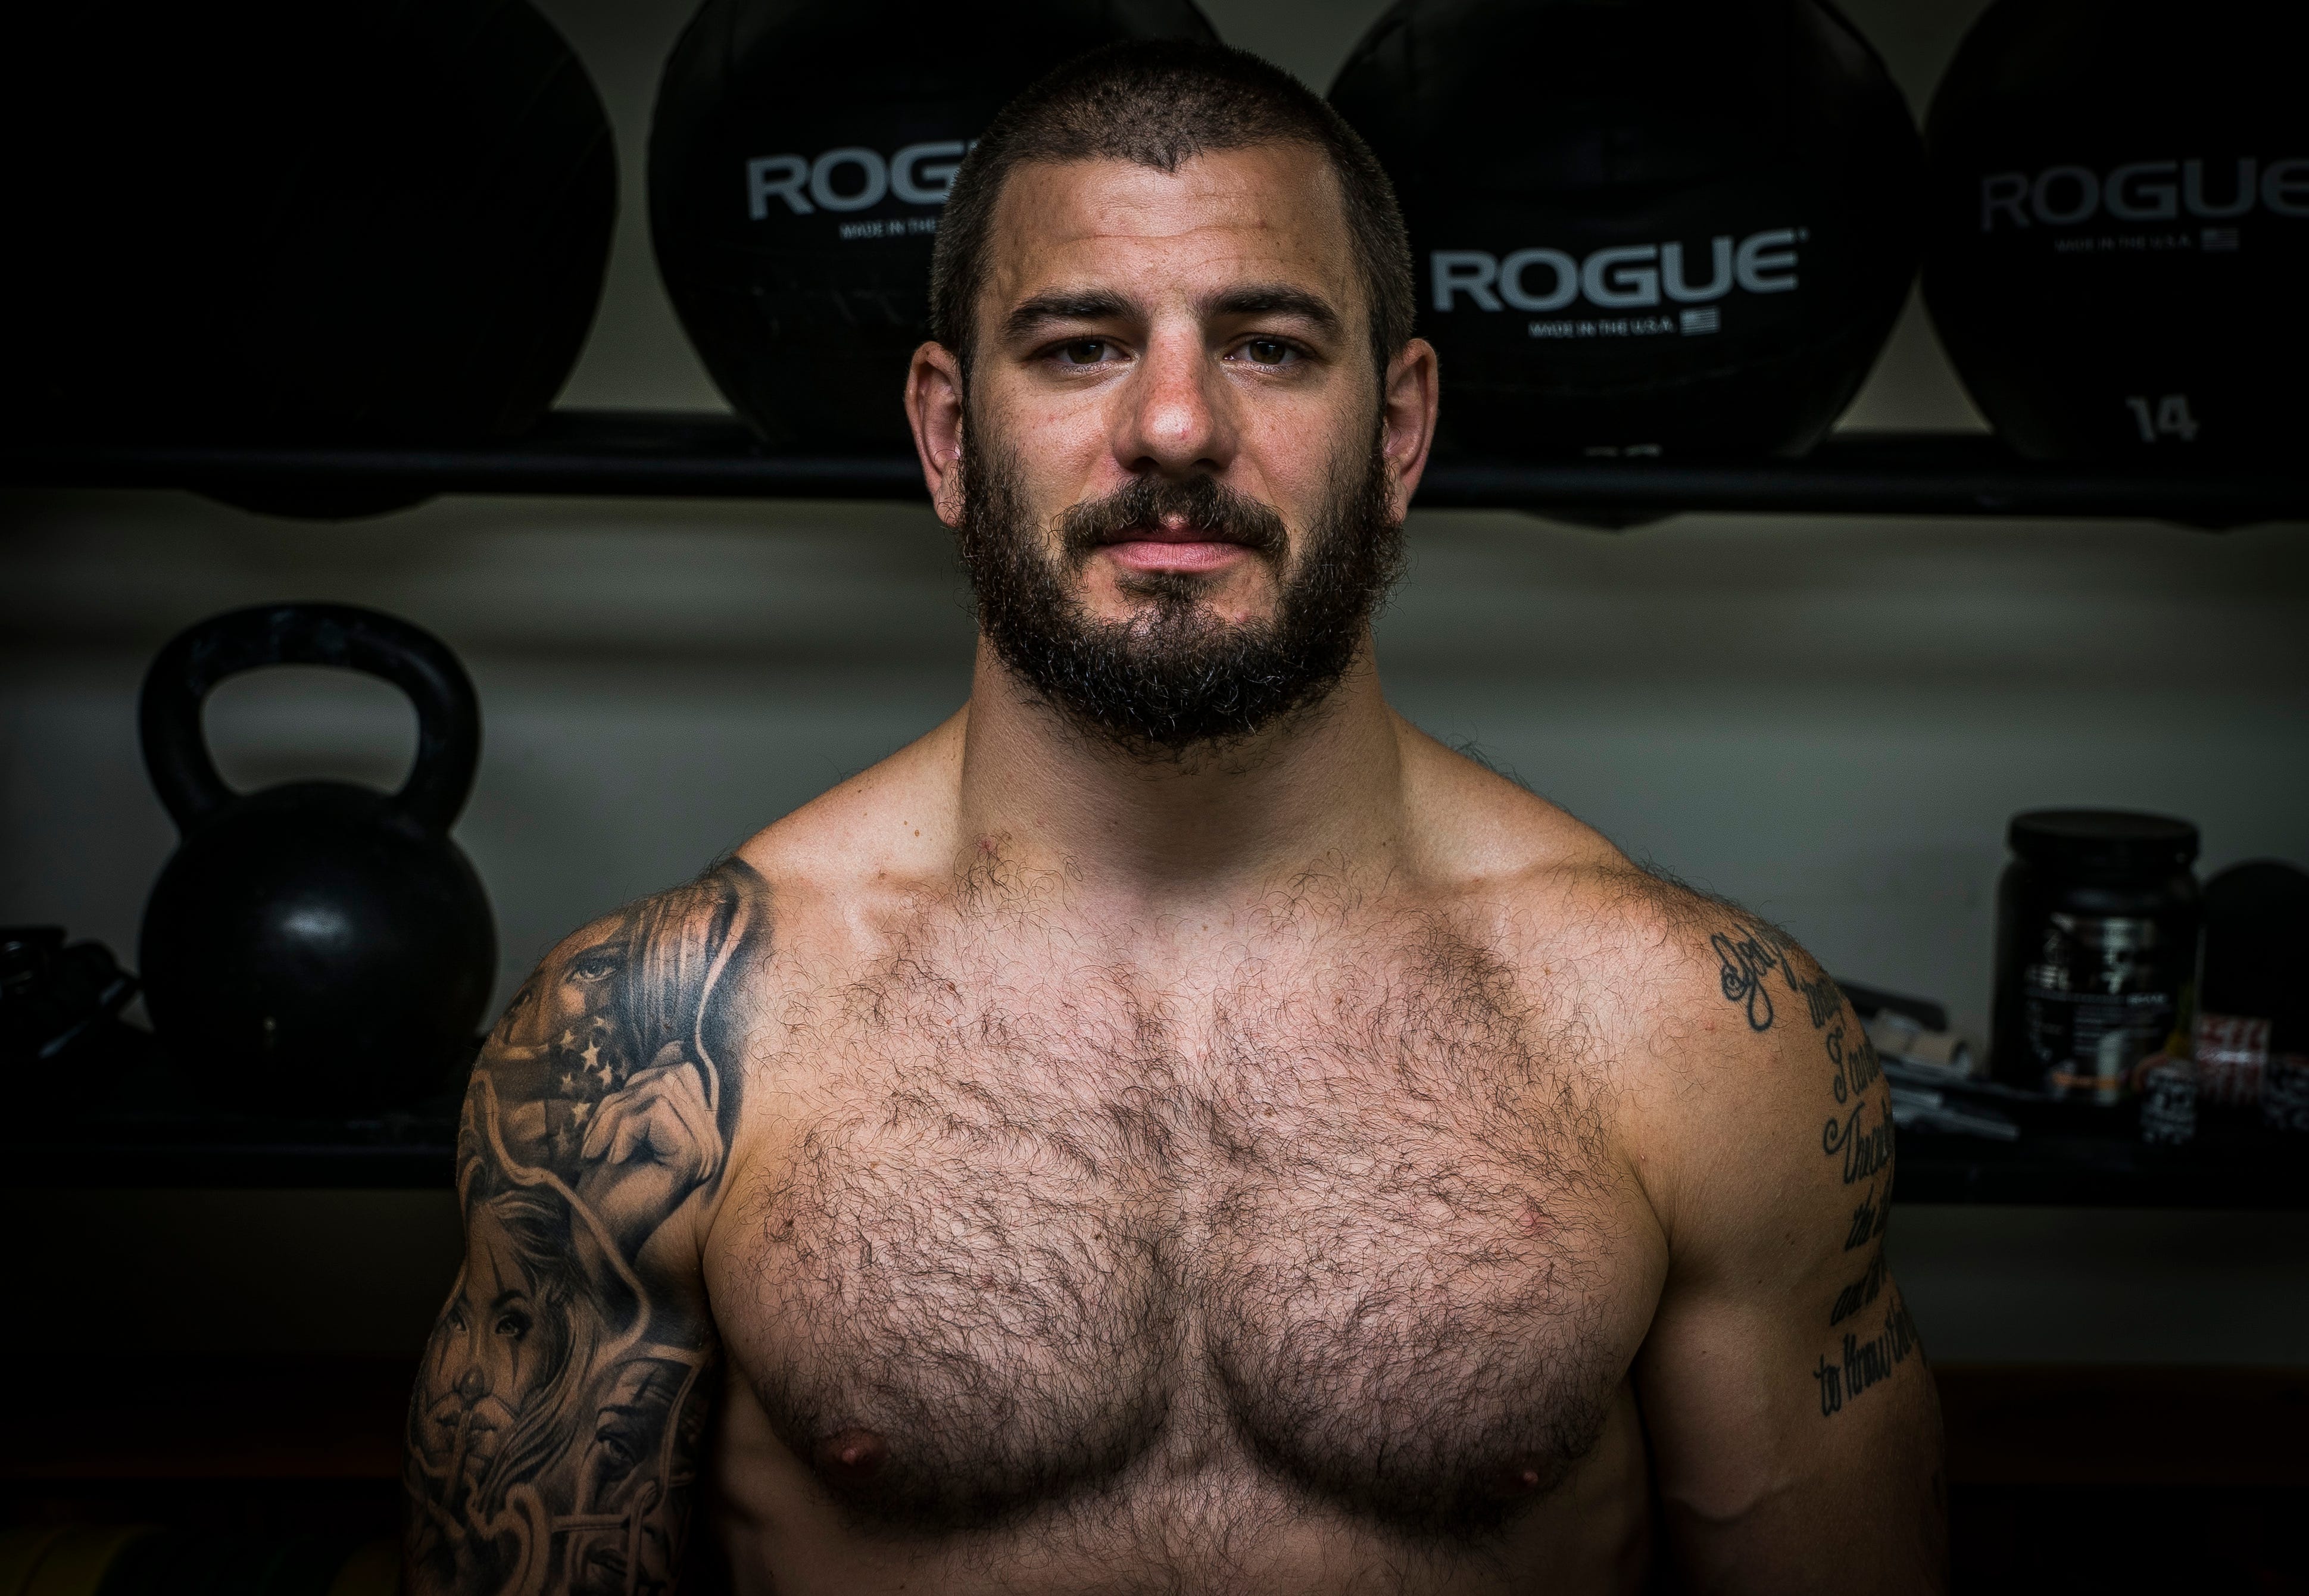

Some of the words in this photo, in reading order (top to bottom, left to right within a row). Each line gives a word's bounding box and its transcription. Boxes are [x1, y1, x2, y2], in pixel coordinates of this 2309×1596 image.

[745, 139, 979, 221] ROG
[1979, 155, 2309, 233] ROGUE
[1430, 227, 1802, 313] ROGUE
[2124, 393, 2202, 444] 14
